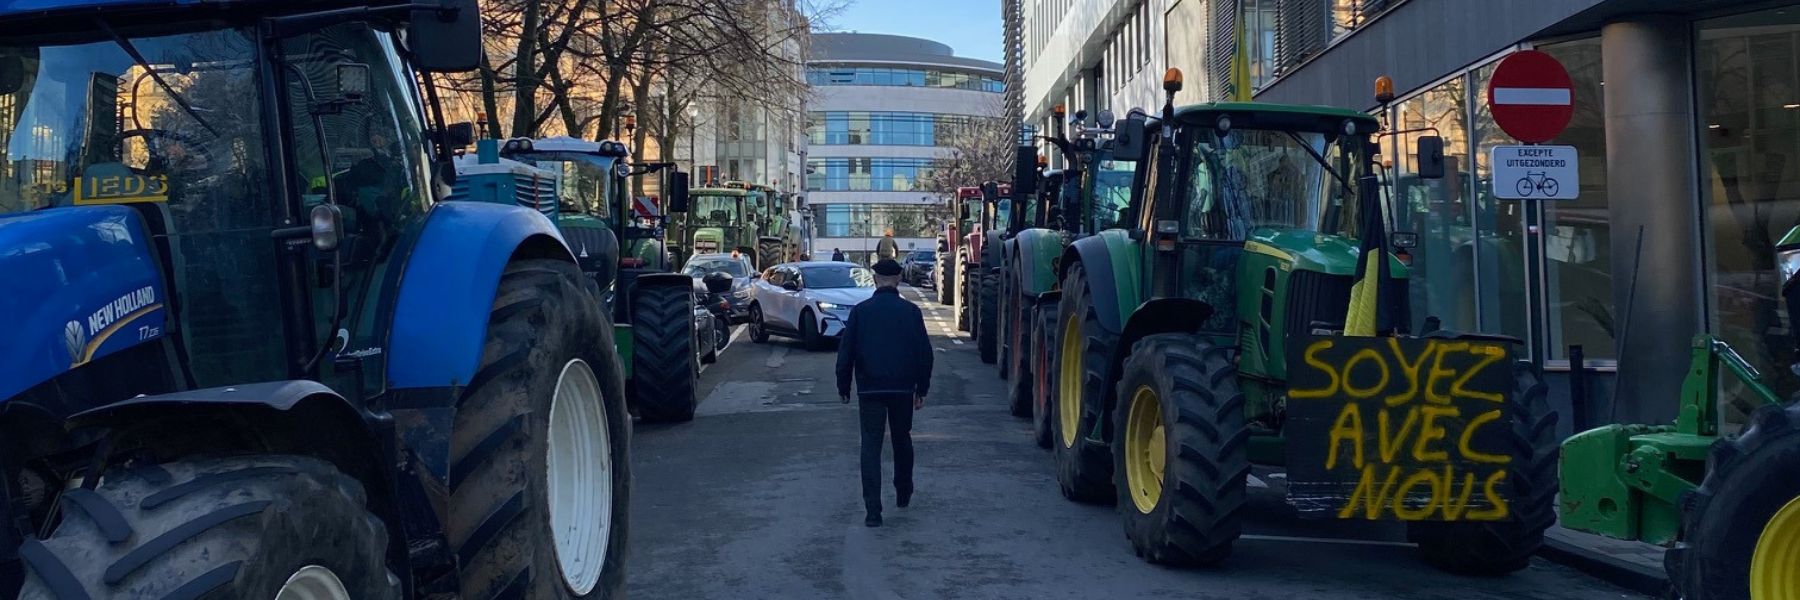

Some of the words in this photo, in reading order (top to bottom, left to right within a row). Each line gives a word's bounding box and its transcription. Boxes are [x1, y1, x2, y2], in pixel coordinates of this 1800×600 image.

[1506, 160, 1566, 168] UITGEZONDERD
[88, 302, 114, 336] NEW
[114, 286, 155, 319] HOLLAND
[1288, 338, 1505, 406] SOYEZ
[1326, 403, 1512, 469] AVEC
[1338, 464, 1509, 520] NOUS
